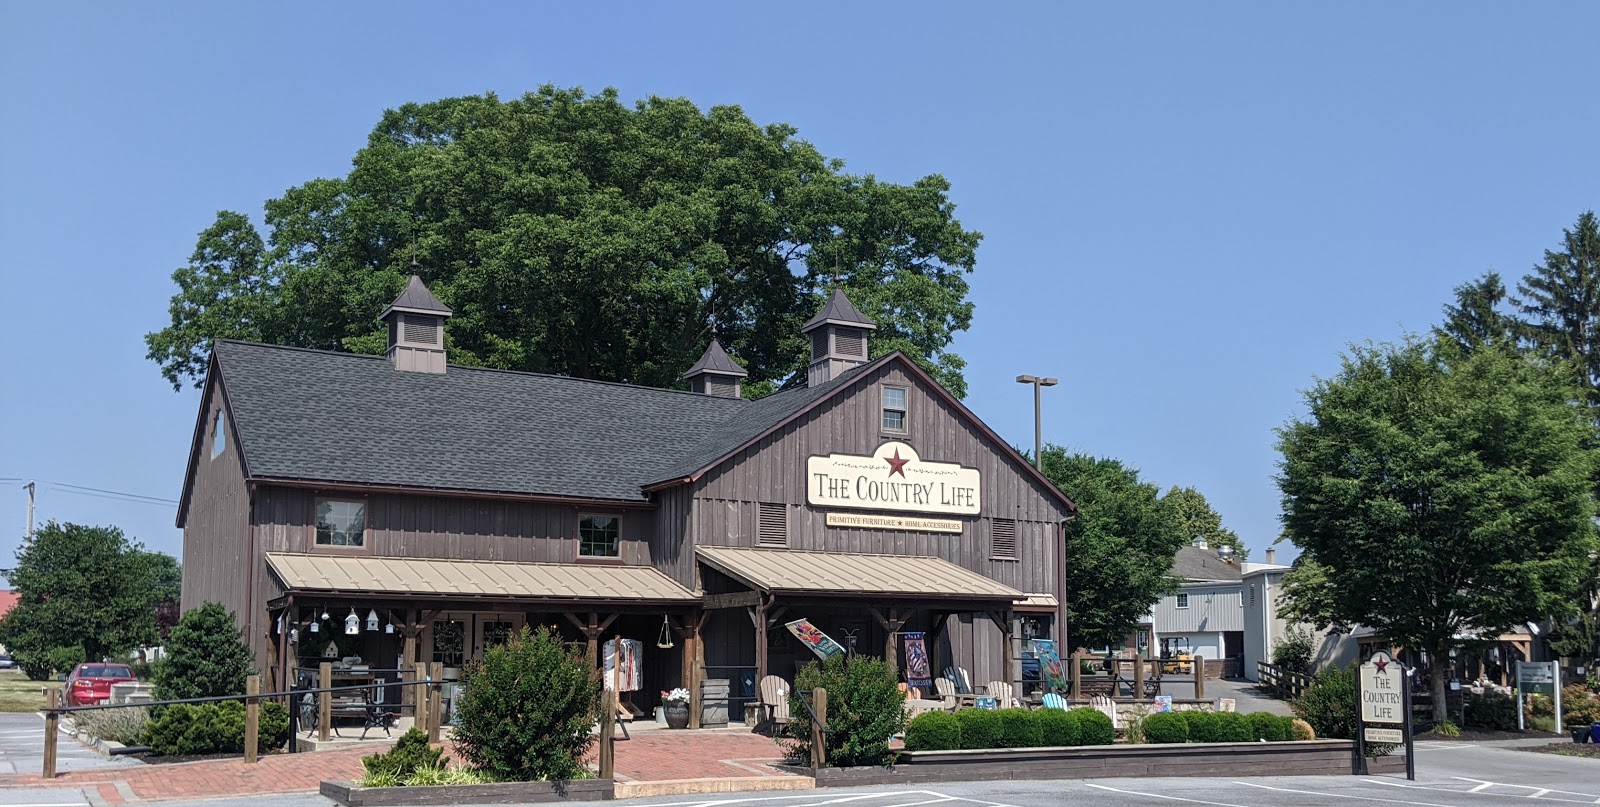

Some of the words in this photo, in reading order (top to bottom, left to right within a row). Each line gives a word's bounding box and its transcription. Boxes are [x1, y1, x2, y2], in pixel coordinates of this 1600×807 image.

[814, 473, 850, 499] THE
[856, 475, 935, 505] COUNTRY
[941, 482, 975, 507] LIFE
[829, 515, 861, 525] PRIMITIVE
[862, 517, 896, 527] FURNITURE
[904, 520, 922, 528] HOME
[922, 521, 961, 530] ACCESSORIES
[1373, 676, 1391, 689] THE
[1363, 690, 1402, 704] COUNTRY
[1374, 705, 1392, 718] LIFE
